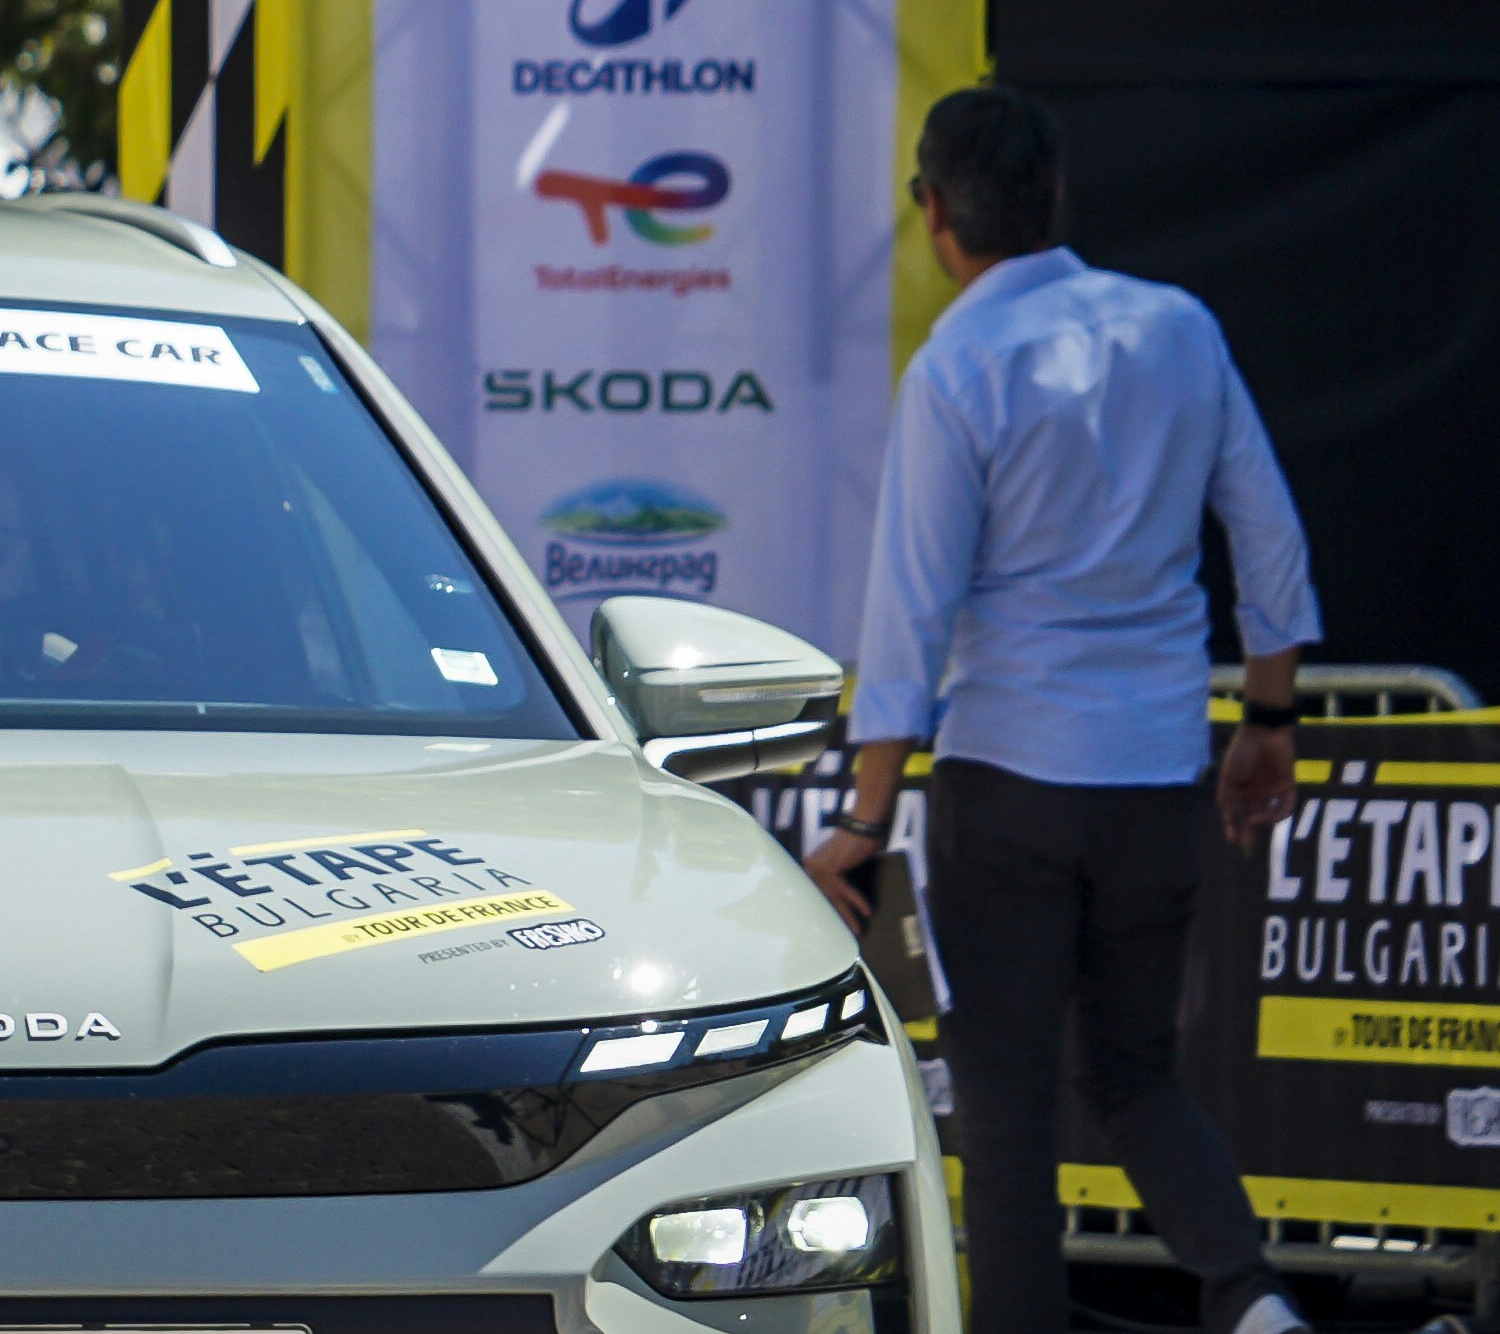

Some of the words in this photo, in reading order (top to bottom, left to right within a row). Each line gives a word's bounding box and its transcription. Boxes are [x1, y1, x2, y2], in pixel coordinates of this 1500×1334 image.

[512, 60, 755, 95] DECATHLON
[534, 265, 732, 298] TotalEnergies
[116, 338, 222, 365] CAR
[130, 837, 487, 910] L'ÉTAPE
[191, 866, 533, 939] BULGARIA
[353, 915, 429, 938] TOUR
[423, 908, 464, 926] DE
[461, 894, 561, 923] FRANCE
[416, 940, 496, 965] PRESENTED
